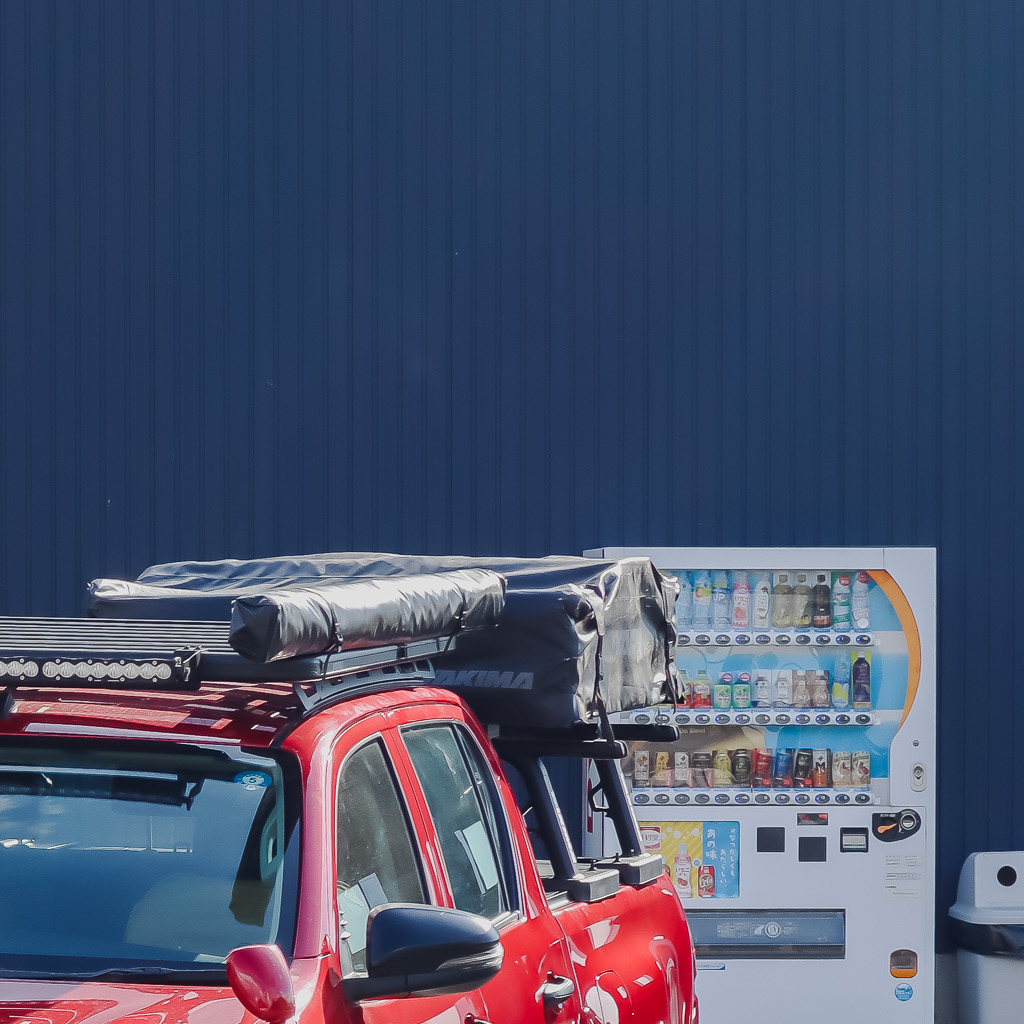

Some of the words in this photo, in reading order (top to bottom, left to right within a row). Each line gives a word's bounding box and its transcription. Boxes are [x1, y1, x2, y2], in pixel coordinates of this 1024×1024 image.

[423, 669, 534, 690] AKIMA
[706, 828, 717, 860] あの味
